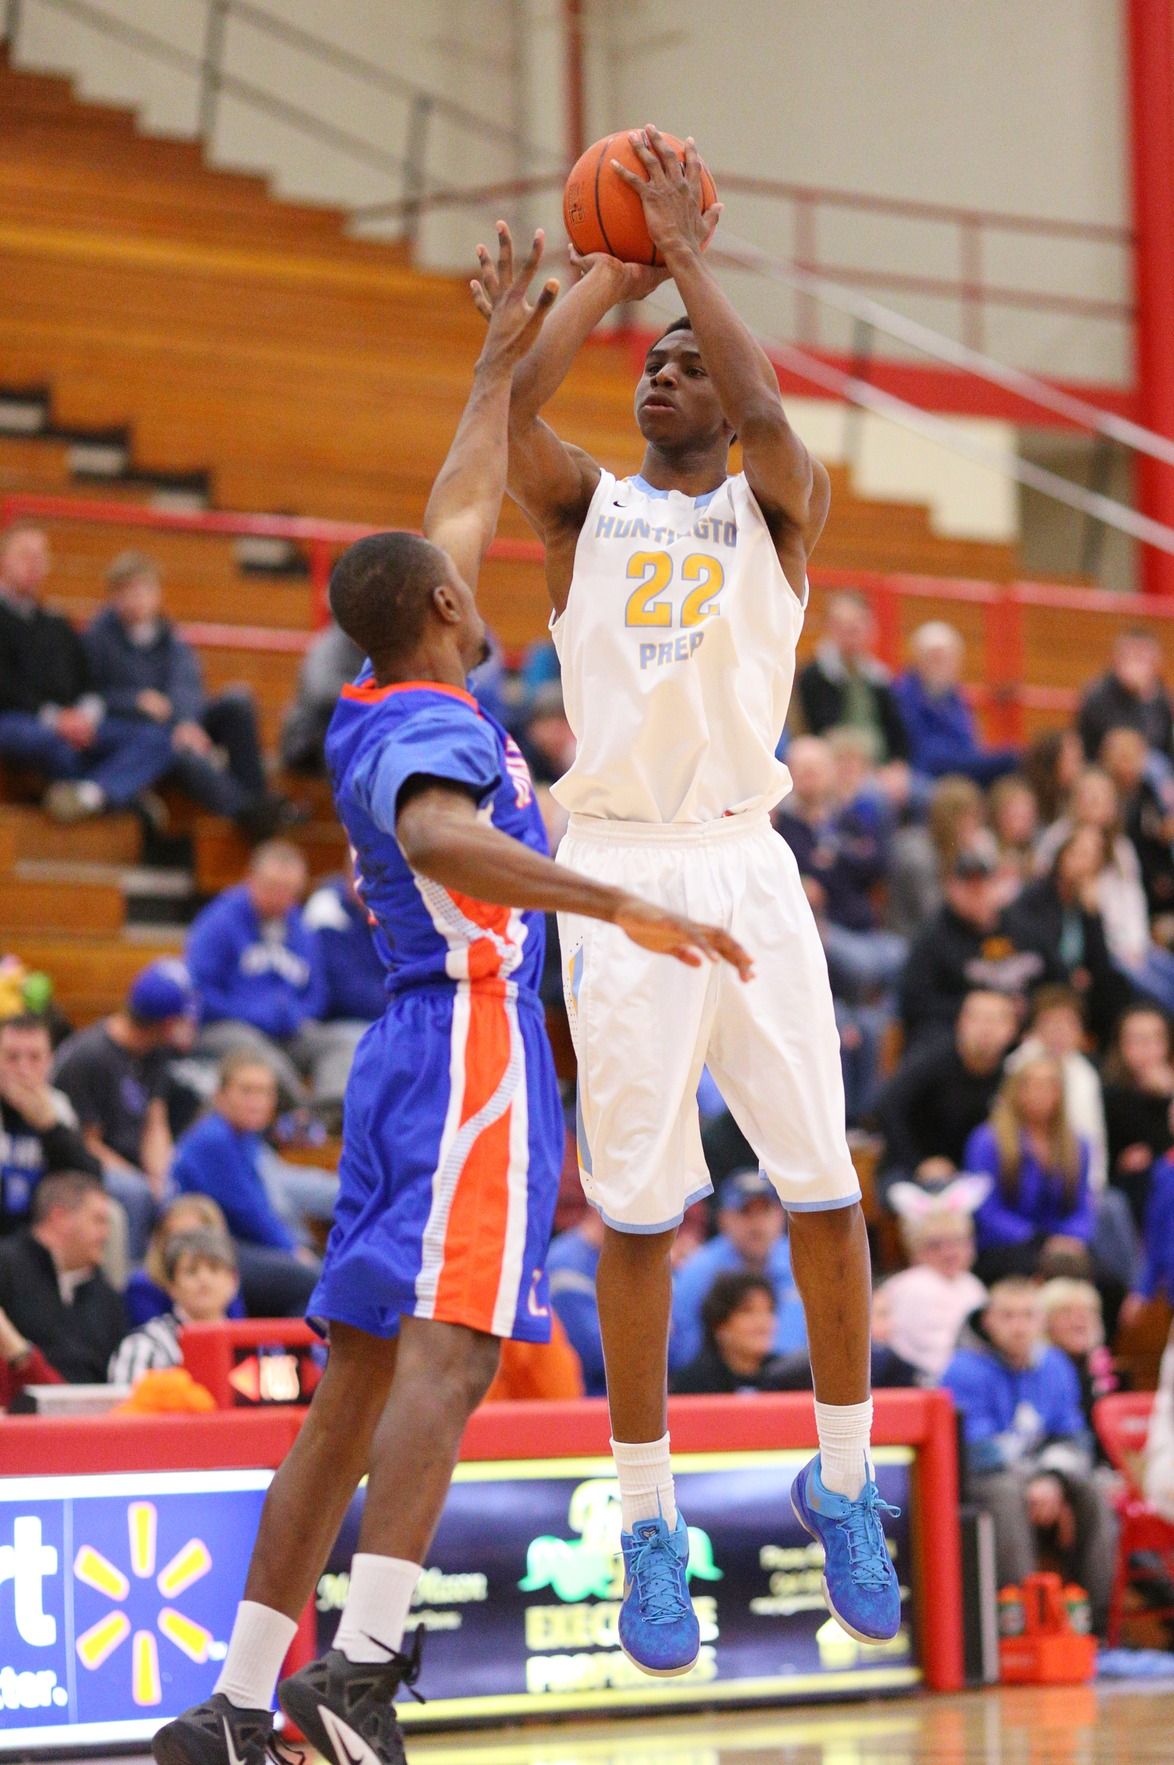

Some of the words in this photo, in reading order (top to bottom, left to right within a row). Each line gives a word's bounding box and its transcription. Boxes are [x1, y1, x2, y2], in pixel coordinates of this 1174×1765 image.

[595, 514, 738, 548] HUNTIGTO
[625, 551, 725, 628] 22
[639, 631, 704, 669] PREP
[0, 1515, 58, 1647] t
